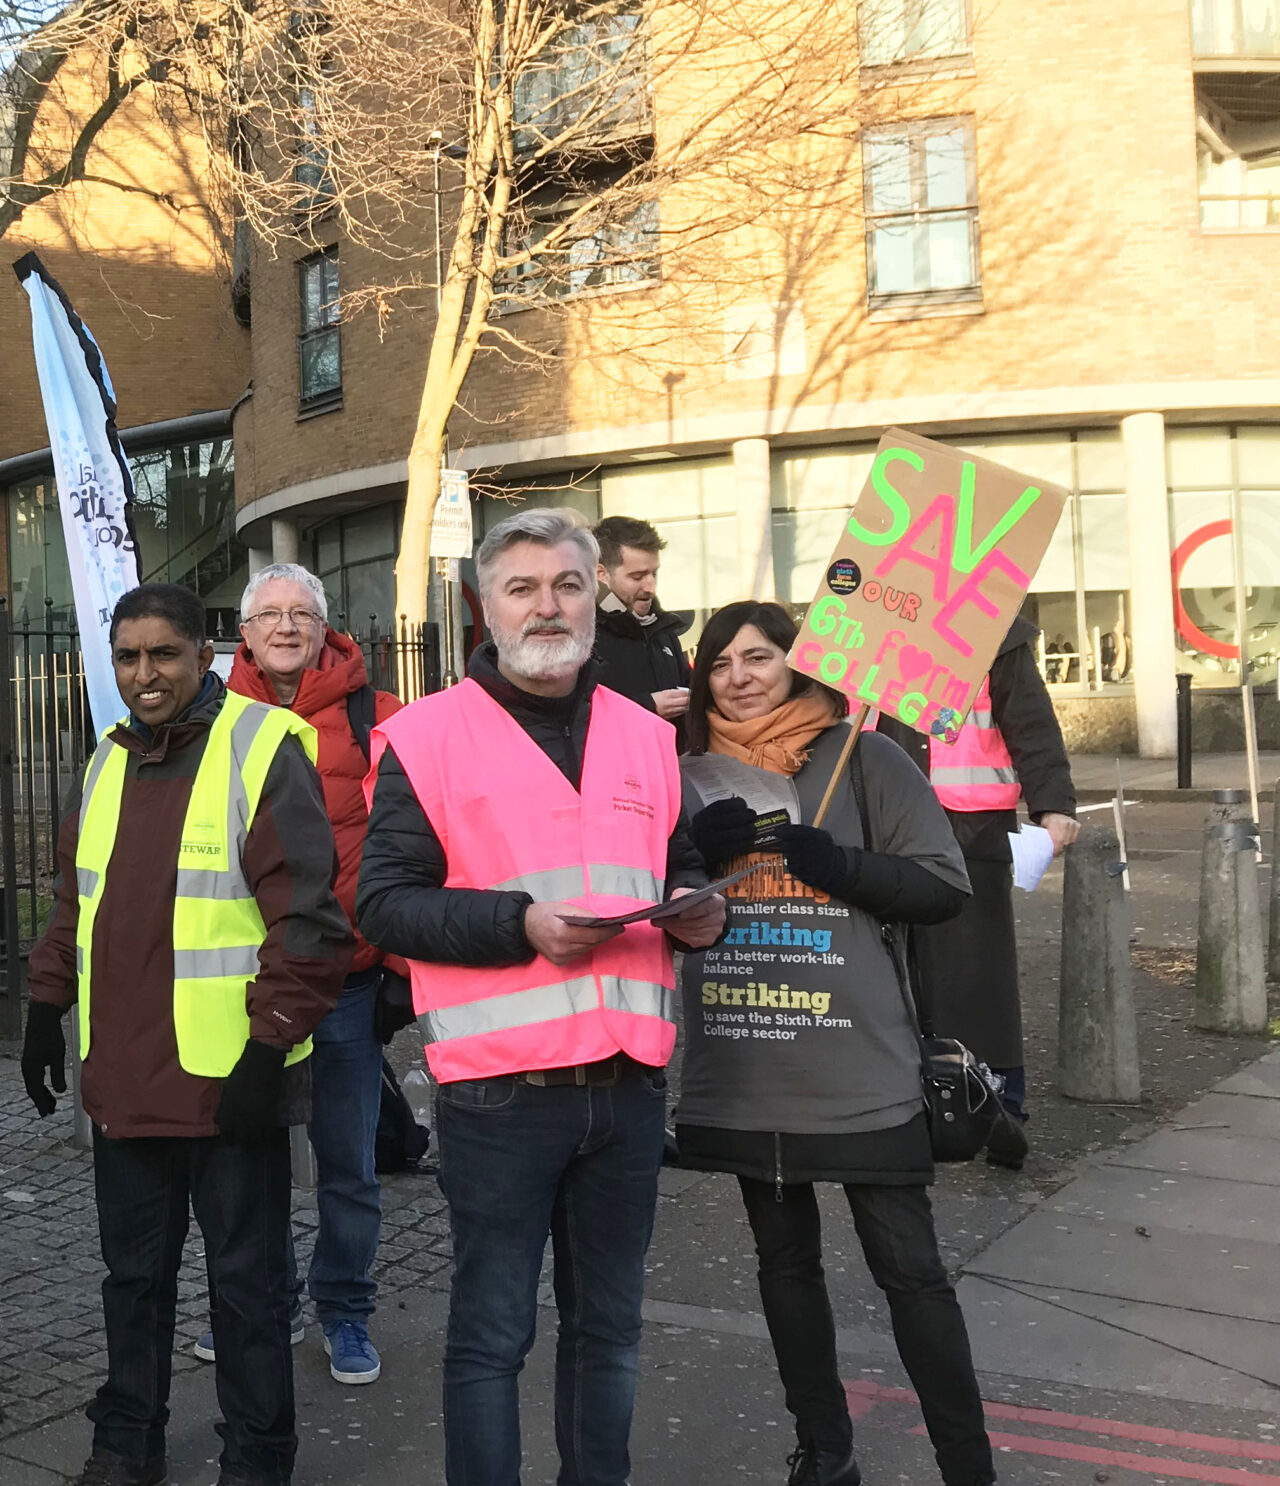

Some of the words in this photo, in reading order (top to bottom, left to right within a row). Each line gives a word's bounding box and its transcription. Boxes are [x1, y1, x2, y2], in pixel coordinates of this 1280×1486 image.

[440, 504, 464, 516] Permit
[847, 447, 1042, 659] SAVE
[862, 580, 922, 622] OUR
[730, 902, 777, 915] maller
[779, 903, 814, 915] class
[817, 904, 850, 917] sizes
[724, 921, 833, 953] triking
[704, 950, 720, 961] for
[723, 951, 732, 962] a
[735, 950, 777, 962] better
[780, 952, 845, 966] work-life
[703, 963, 754, 975] balance
[701, 981, 832, 1016] Striking
[704, 1010, 714, 1021] to
[716, 1012, 746, 1023] save
[748, 1011, 772, 1024] the
[775, 1013, 812, 1027] Sixth
[815, 1015, 853, 1028] Form
[703, 1024, 750, 1040] College
[752, 1027, 798, 1041] sector
